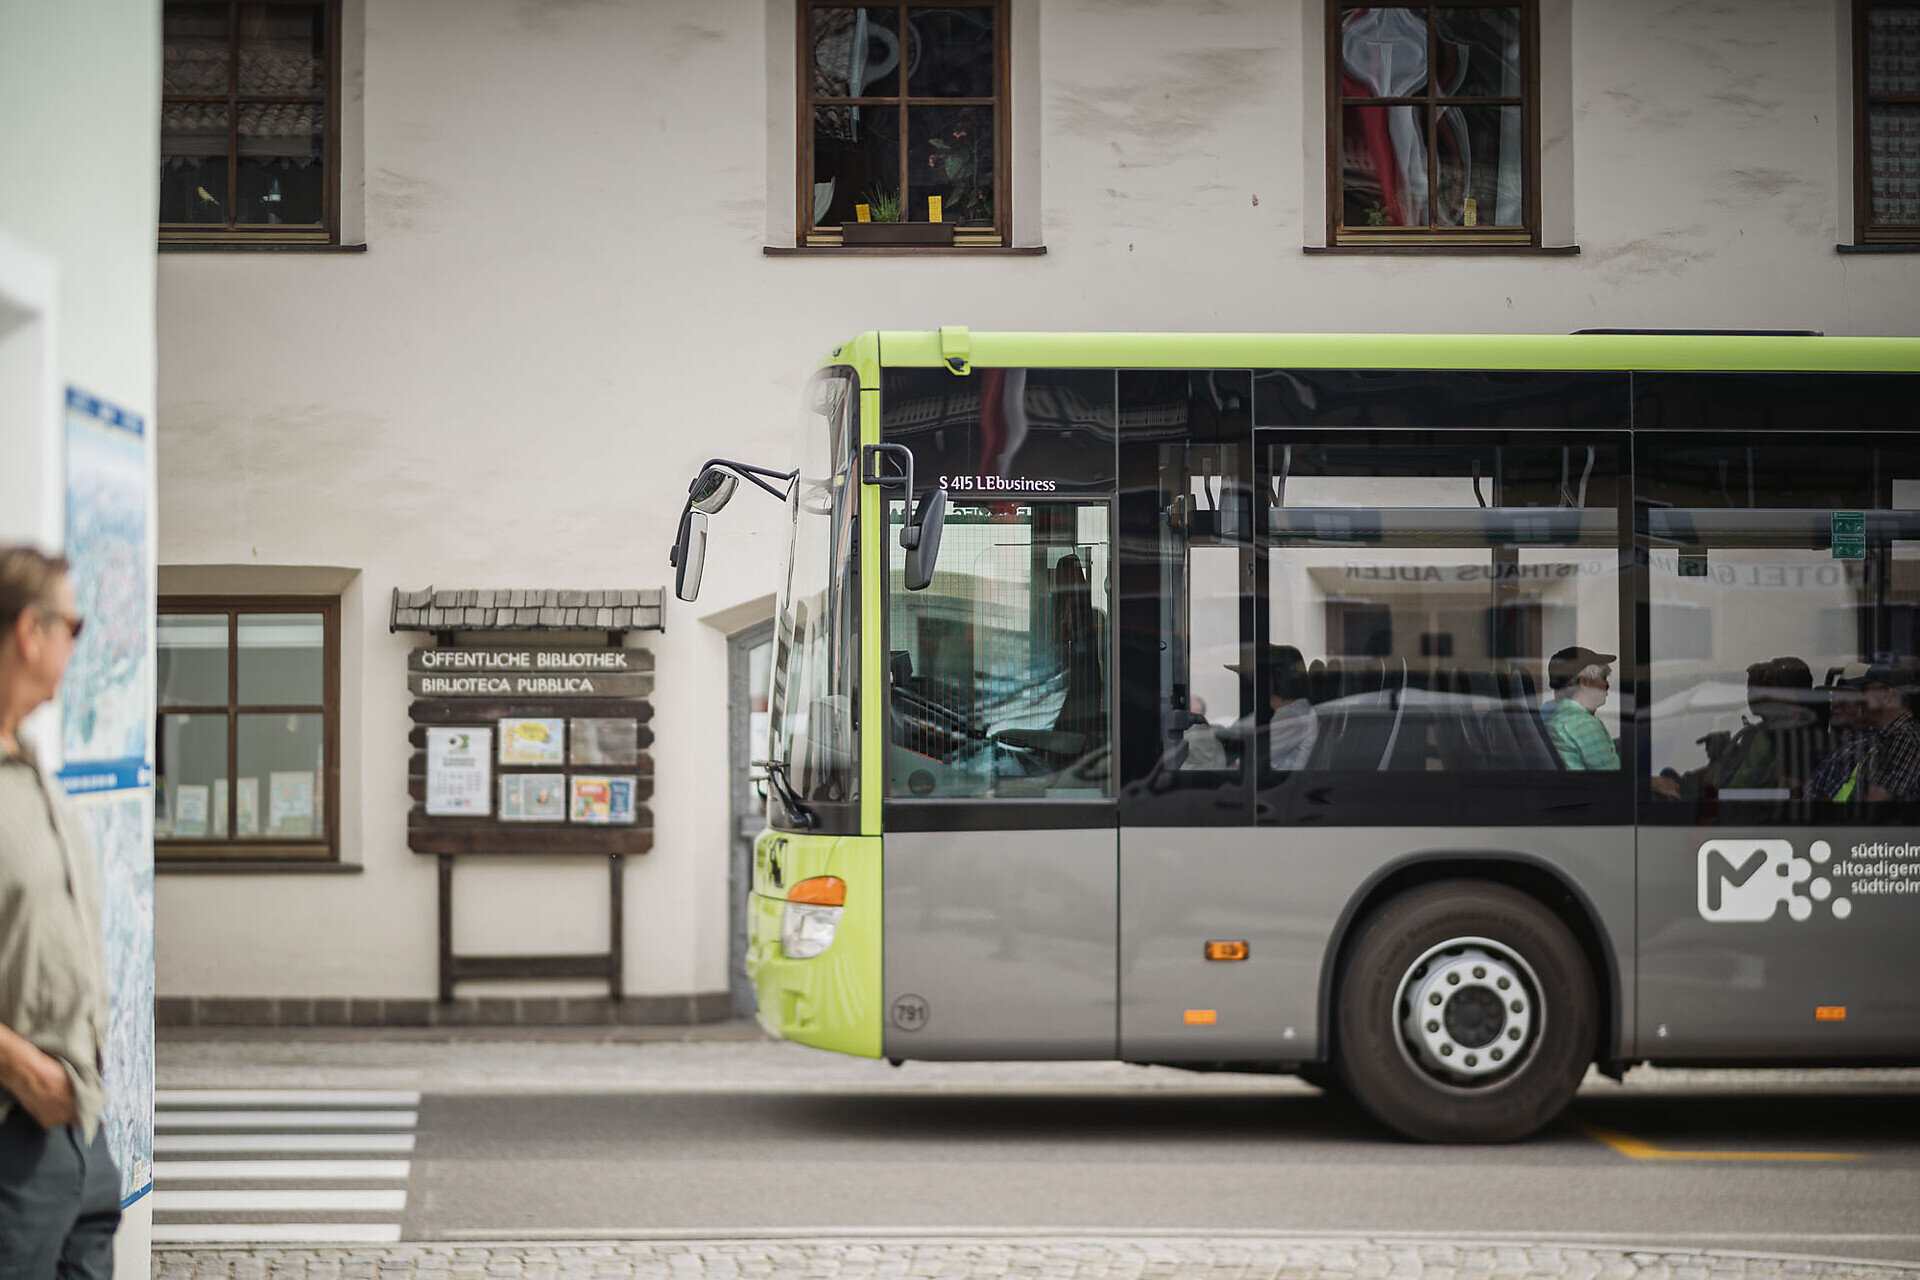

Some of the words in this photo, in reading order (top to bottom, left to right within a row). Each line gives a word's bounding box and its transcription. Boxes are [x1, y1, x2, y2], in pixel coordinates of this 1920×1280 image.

[939, 475, 948, 490] S
[951, 475, 973, 490] 415
[976, 475, 1056, 491] LEbusiness
[422, 650, 530, 667] ÖFFENTLICHE
[537, 652, 627, 668] BIBLIOTHEK
[422, 677, 511, 693] BIBLIOTECA
[518, 677, 594, 693] PUBBLICA
[897, 1004, 924, 1021] 791
